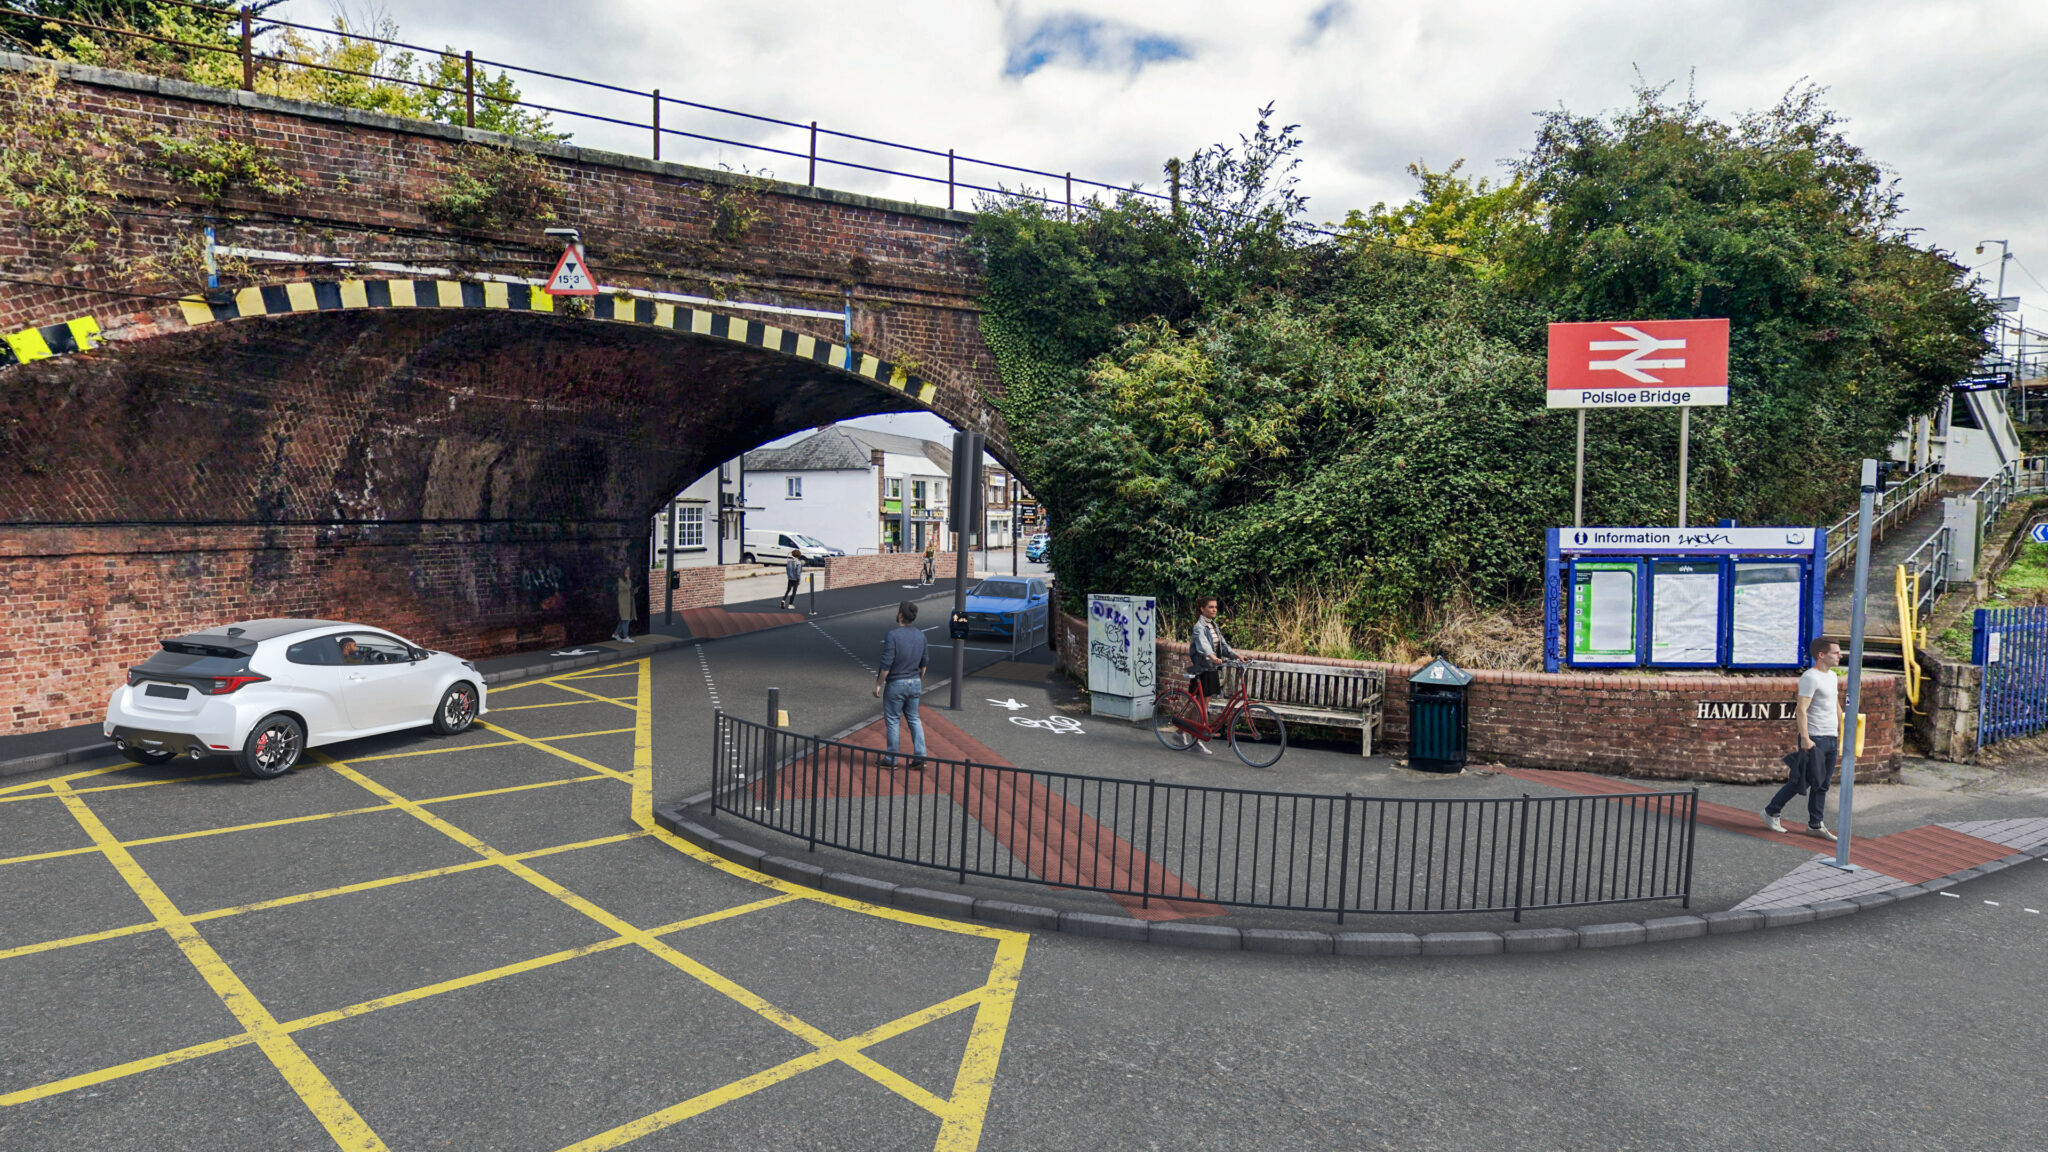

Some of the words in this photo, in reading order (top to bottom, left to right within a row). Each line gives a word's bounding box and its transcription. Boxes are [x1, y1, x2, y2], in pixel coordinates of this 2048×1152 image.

[1582, 391, 1637, 404] Polsloe
[1640, 390, 1691, 405] Bridge
[1595, 532, 1670, 543] Information
[1696, 703, 1771, 719] HAMLIN
